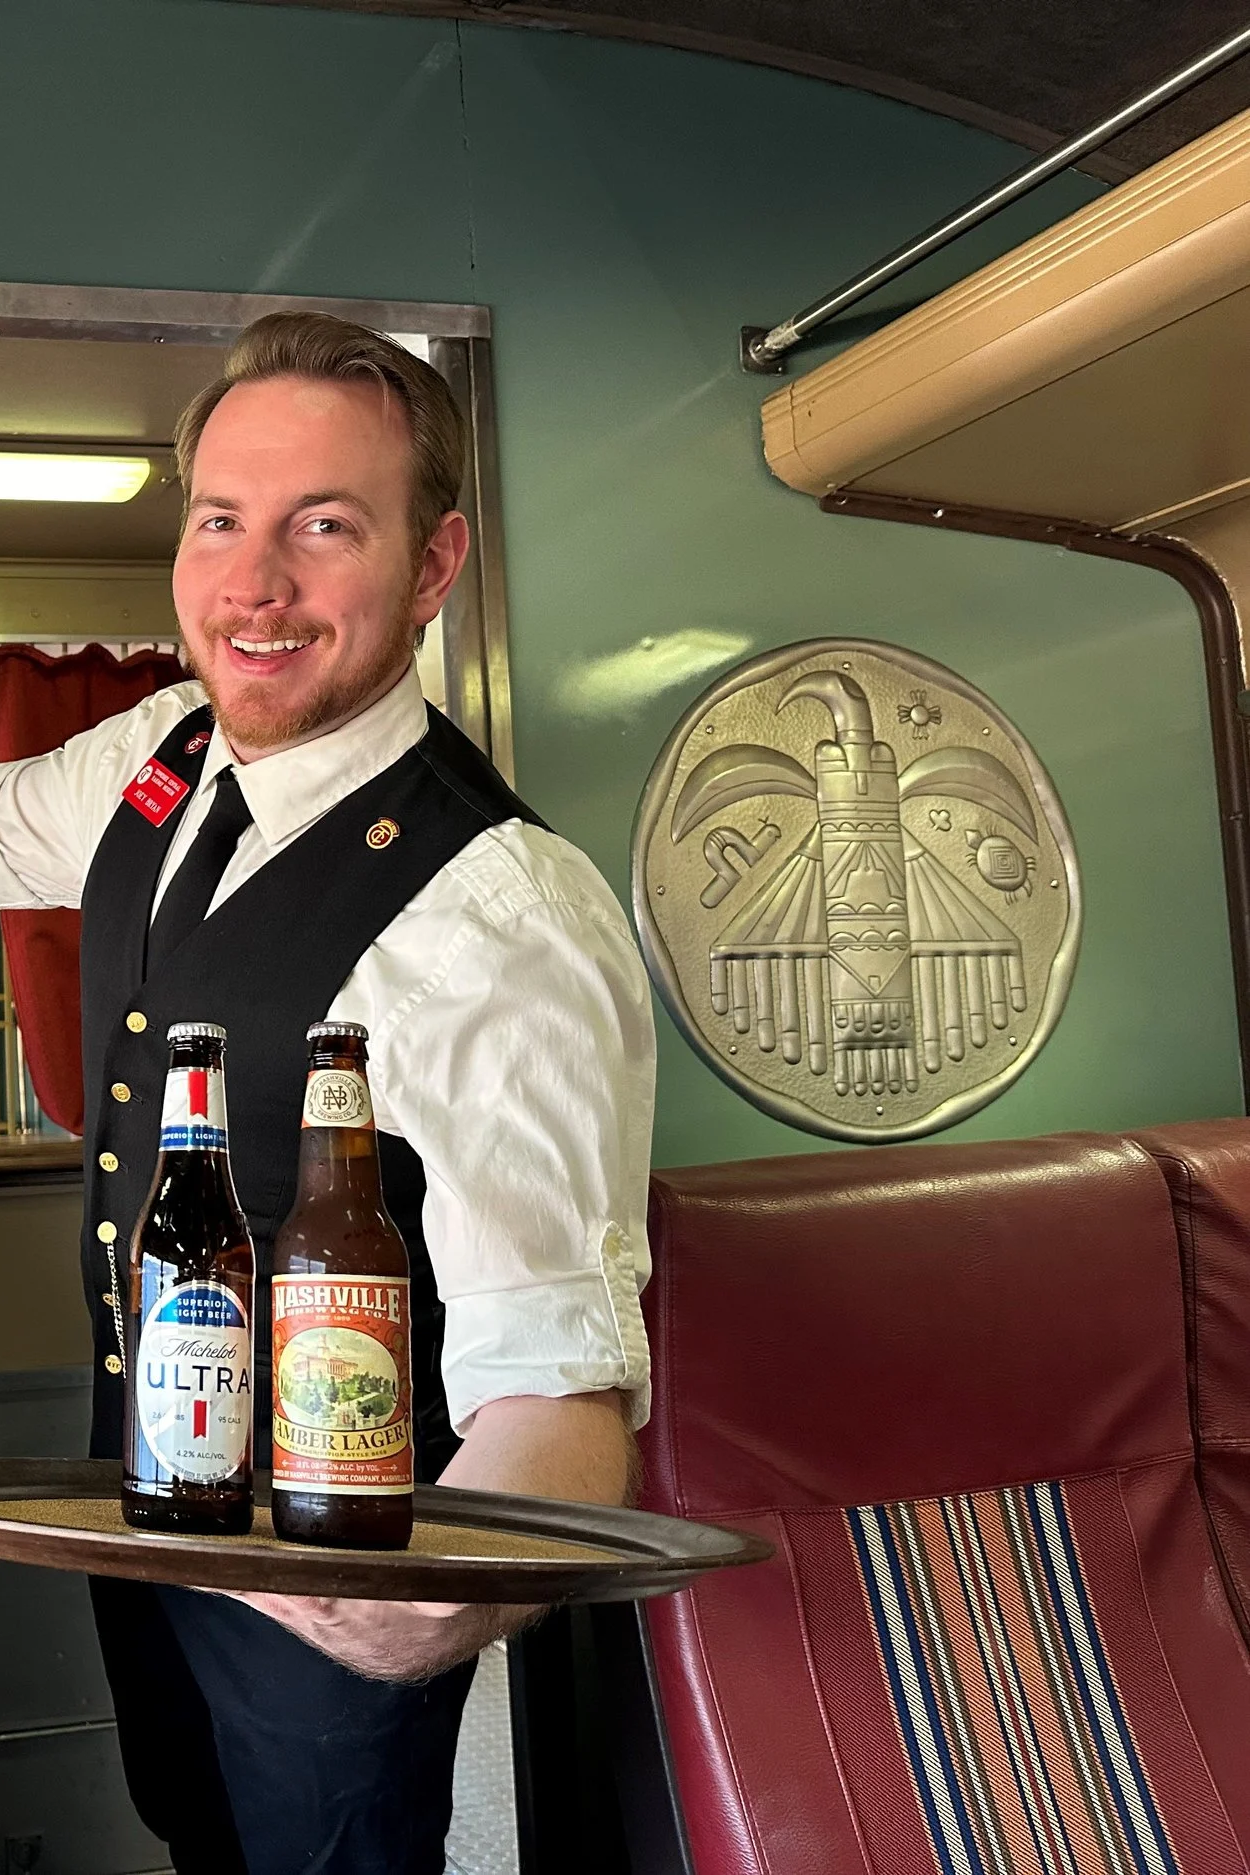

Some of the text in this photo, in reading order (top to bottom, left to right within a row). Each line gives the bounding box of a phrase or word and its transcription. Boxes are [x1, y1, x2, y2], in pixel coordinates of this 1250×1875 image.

[318, 1075, 352, 1087] NASHVILLE
[161, 1132, 193, 1140] SUPERIOR
[177, 1298, 228, 1308] SUPERIOR
[274, 1285, 401, 1324] NASHVILLE
[173, 1309, 232, 1320] LIGHT BEER
[286, 1306, 386, 1320] BREWING CO.
[161, 1338, 238, 1360] Michelob
[147, 1362, 251, 1394] ULTRA
[217, 1416, 227, 1424] 95
[275, 1421, 405, 1451] AMBER LAGER
[176, 1449, 195, 1458] 4.2%
[355, 1463, 365, 1473] by
[319, 1472, 350, 1482] BREWING
